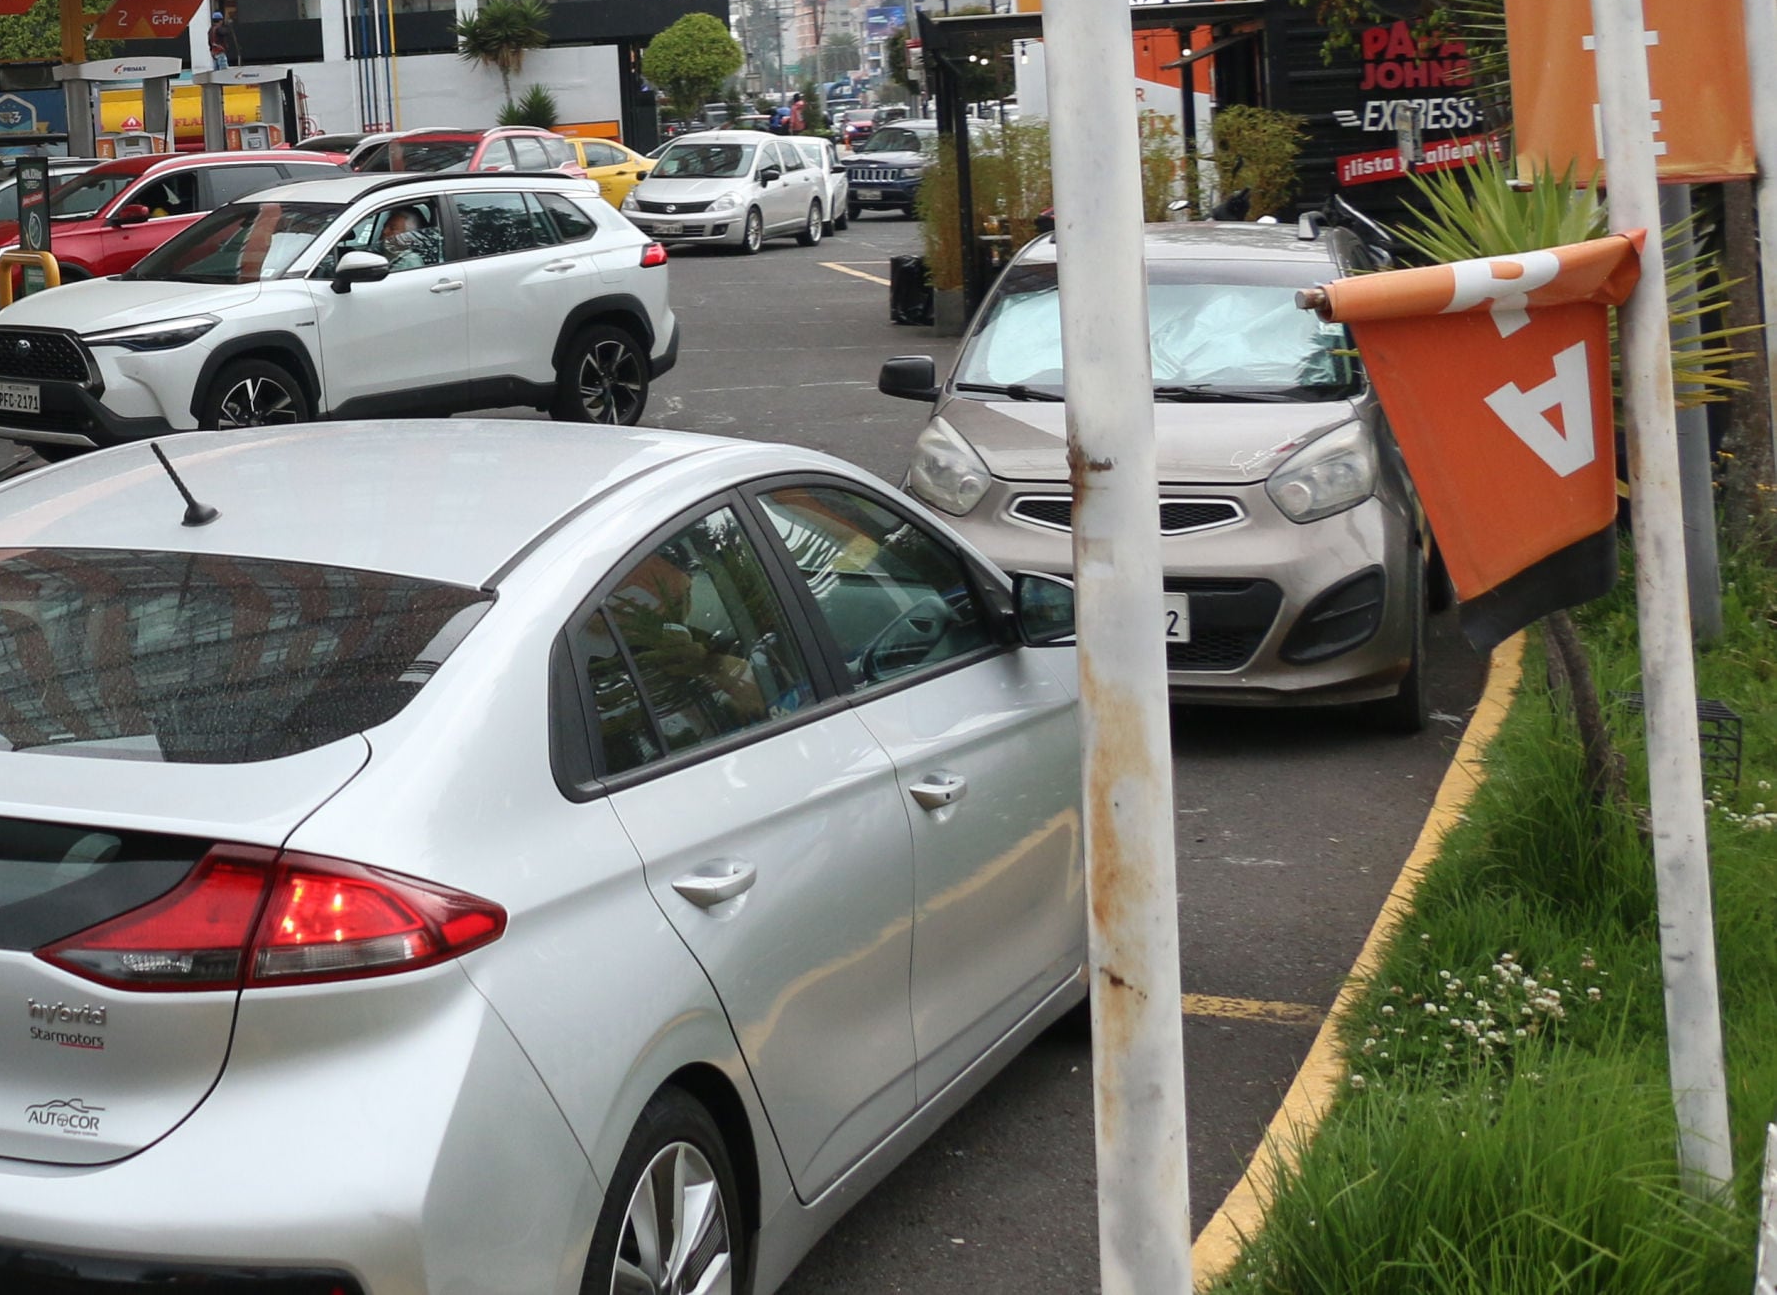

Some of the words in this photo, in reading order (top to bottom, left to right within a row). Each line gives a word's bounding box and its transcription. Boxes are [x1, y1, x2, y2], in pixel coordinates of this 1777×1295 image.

[118, 10, 127, 26] 2
[152, 15, 183, 25] G-Prix
[27, 998, 107, 1026] hybrid
[30, 1026, 105, 1047] Starmotors
[27, 1110, 100, 1132] AUTOCOR
